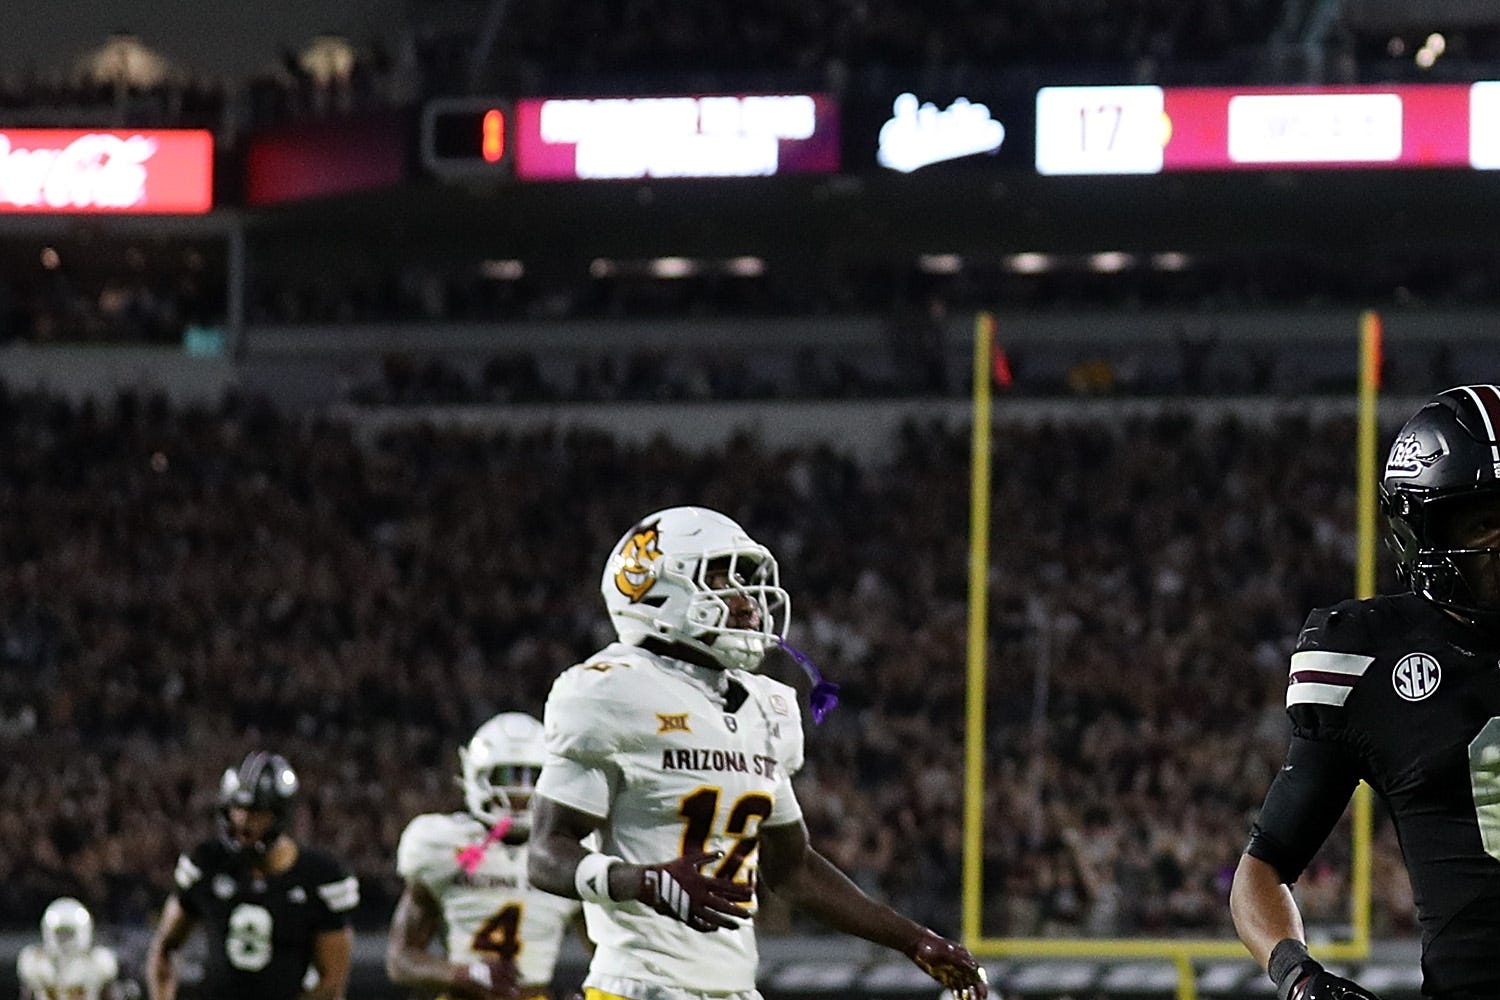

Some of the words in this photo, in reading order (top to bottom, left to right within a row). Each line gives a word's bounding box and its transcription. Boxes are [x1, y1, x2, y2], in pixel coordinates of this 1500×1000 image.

[1080, 105, 1123, 152] 17
[1395, 655, 1438, 698] SEC
[663, 749, 749, 774] ARIZONA
[677, 785, 775, 908] 12
[227, 903, 274, 972] 8
[470, 901, 524, 963] 4
